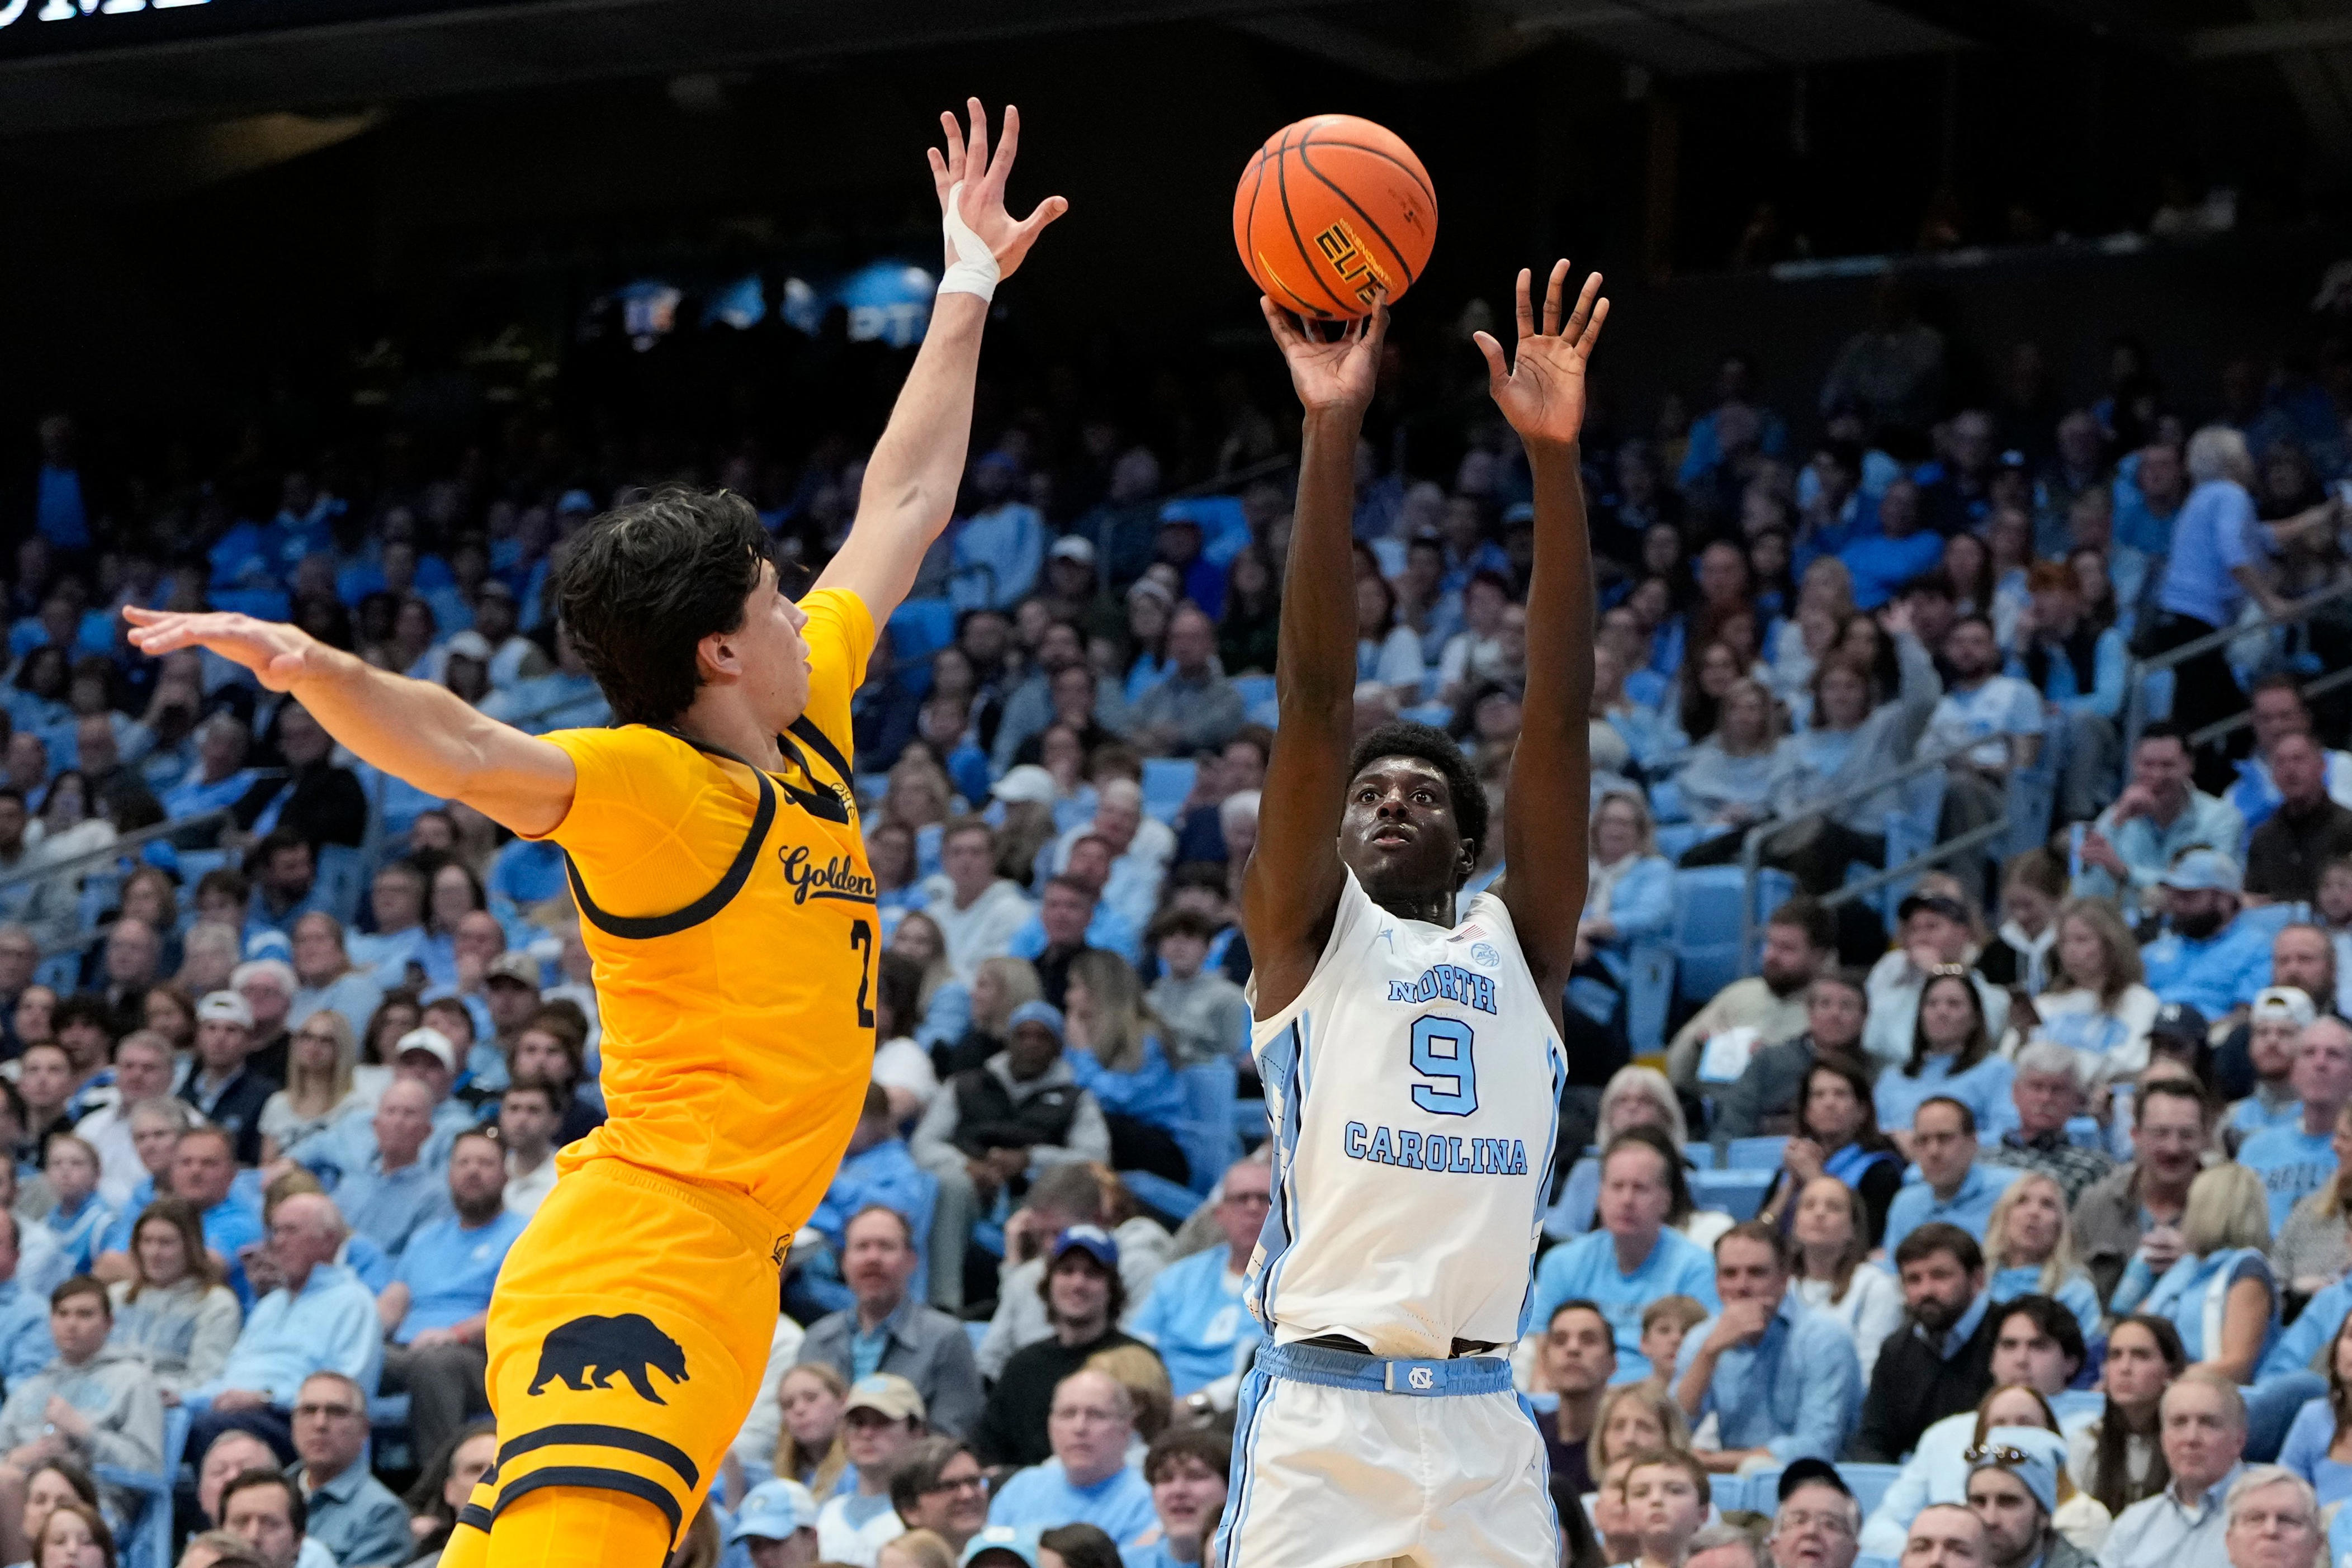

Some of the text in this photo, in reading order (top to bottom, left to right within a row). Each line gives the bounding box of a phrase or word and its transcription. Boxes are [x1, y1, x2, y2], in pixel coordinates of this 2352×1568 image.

[1314, 222, 1390, 306] ELITE
[778, 845, 875, 905] Golden
[850, 920, 874, 1028] 2
[1476, 950, 1497, 958] ACC
[1388, 964, 1497, 1015] NORTH
[1410, 1015, 1478, 1117] 9
[1345, 1121, 1527, 1174] CAROLINA
